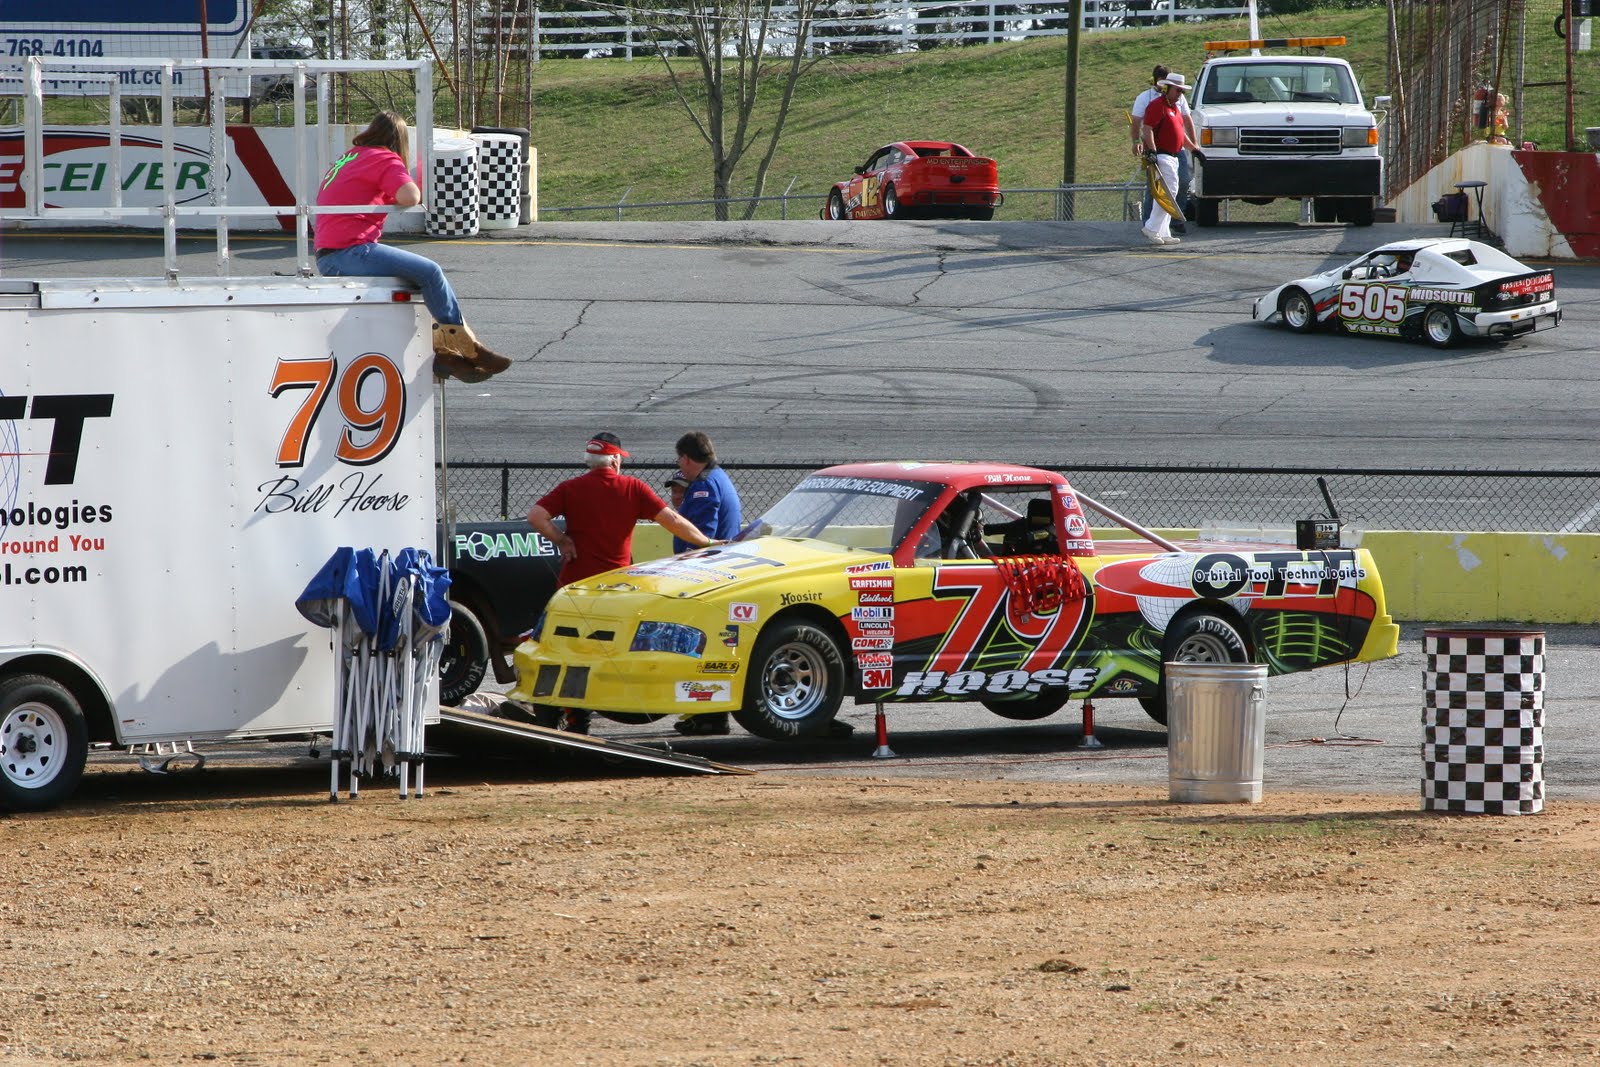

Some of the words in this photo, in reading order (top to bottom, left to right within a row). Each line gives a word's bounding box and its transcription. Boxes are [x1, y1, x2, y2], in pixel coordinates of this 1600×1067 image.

[1339, 283, 1410, 324] 505
[1410, 288, 1474, 304] MIDSOUTH
[267, 351, 407, 469] 79
[984, 474, 1004, 484] Bill
[254, 474, 335, 514] Bill
[333, 471, 413, 519] Hoose
[865, 480, 925, 501] EQUIPMENT
[69, 535, 105, 552] You
[0, 563, 88, 586] l.com
[846, 561, 891, 574] AMSOIL
[1194, 568, 1242, 583] Orbital
[1246, 567, 1275, 581] Tool
[1279, 566, 1366, 581] Technologies
[851, 579, 893, 589] CRAFTSMAN
[780, 589, 823, 606] Hoosier
[859, 593, 893, 603] Edelbrock
[733, 605, 754, 618] CV
[854, 607, 881, 618] Mobil
[883, 607, 892, 618] 1
[853, 638, 884, 648] COMP
[859, 652, 891, 667] Holley
[863, 669, 892, 688] 3M
[896, 667, 1100, 697] HOOSE
